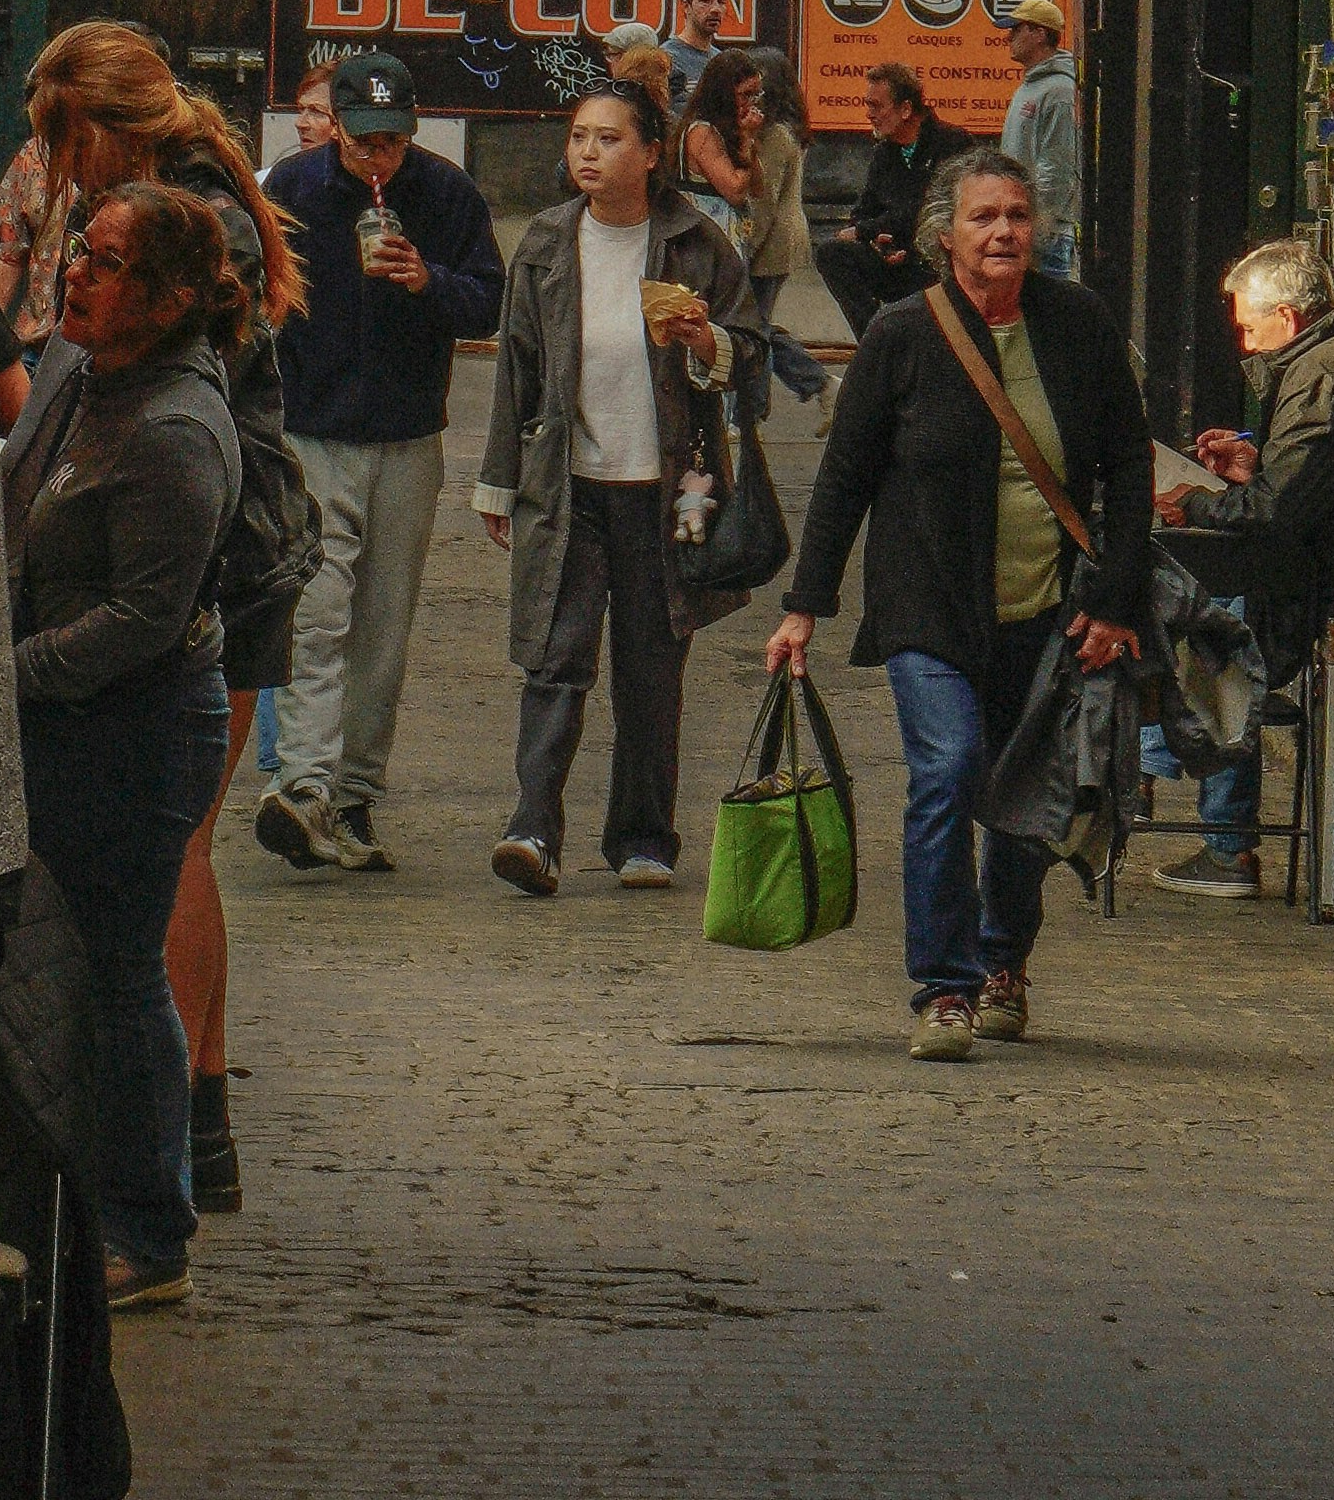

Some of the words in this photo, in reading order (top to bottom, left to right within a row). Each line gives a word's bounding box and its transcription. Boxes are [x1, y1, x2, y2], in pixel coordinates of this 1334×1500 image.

[833, 34, 878, 45] BOTTES
[907, 35, 963, 47] CASQUES
[929, 66, 1023, 80] CONSTRUCT
[369, 77, 392, 103] LA
